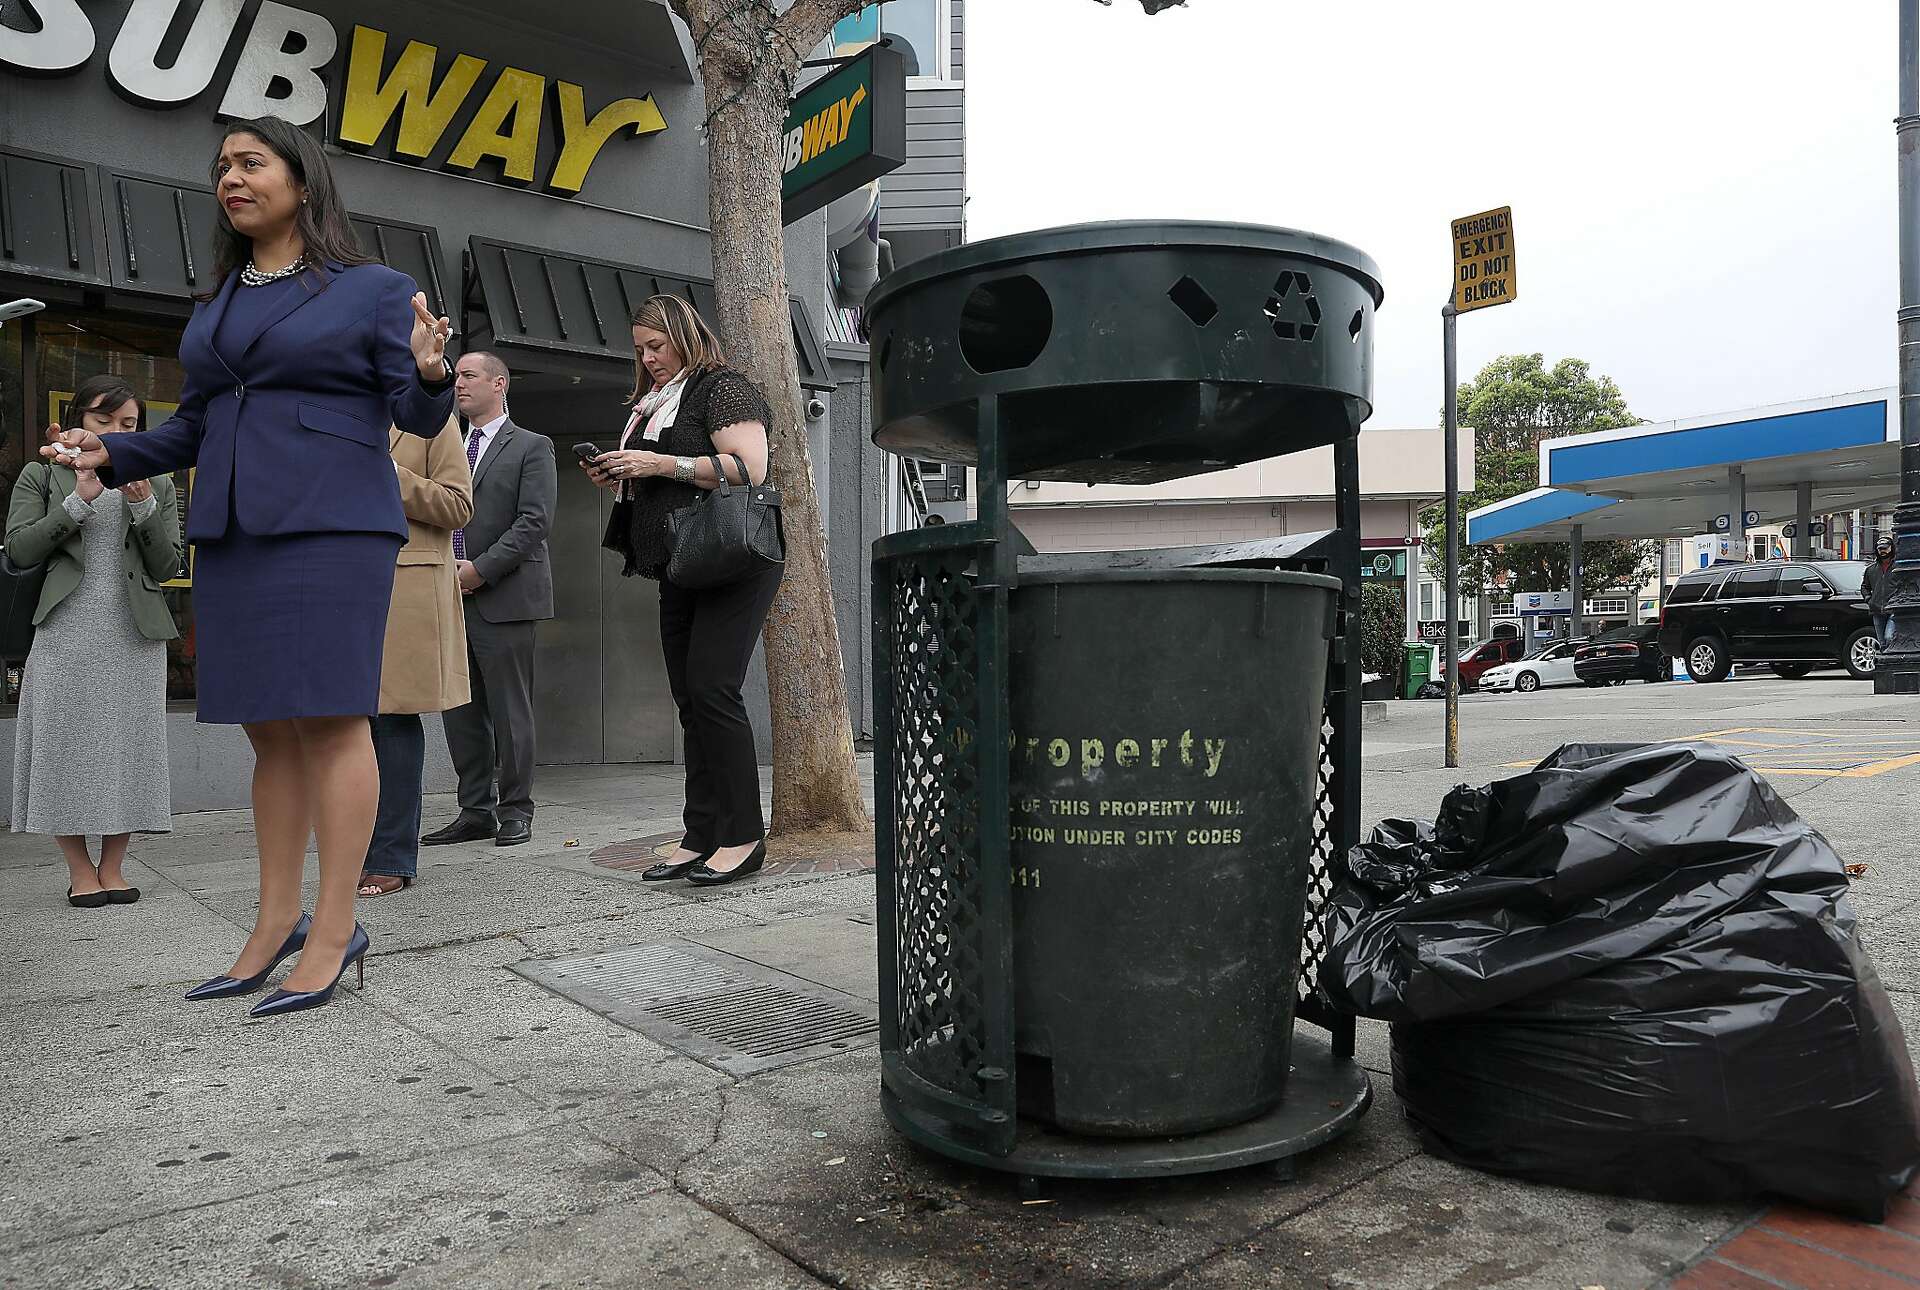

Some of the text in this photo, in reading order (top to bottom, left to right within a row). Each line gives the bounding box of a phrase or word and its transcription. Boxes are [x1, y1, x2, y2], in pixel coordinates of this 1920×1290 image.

[1453, 211, 1509, 240] EMERGENCY
[1460, 231, 1507, 259] EXIT
[1460, 255, 1510, 281] DO NOT
[1464, 278, 1507, 303] BLOCK
[1553, 594, 1560, 602] 2
[1049, 800, 1090, 816] THIS
[1100, 800, 1196, 817] PROPERTY
[1064, 829, 1125, 845] UNDER
[1135, 830, 1177, 845] CITY
[1187, 828, 1242, 845] CODES
